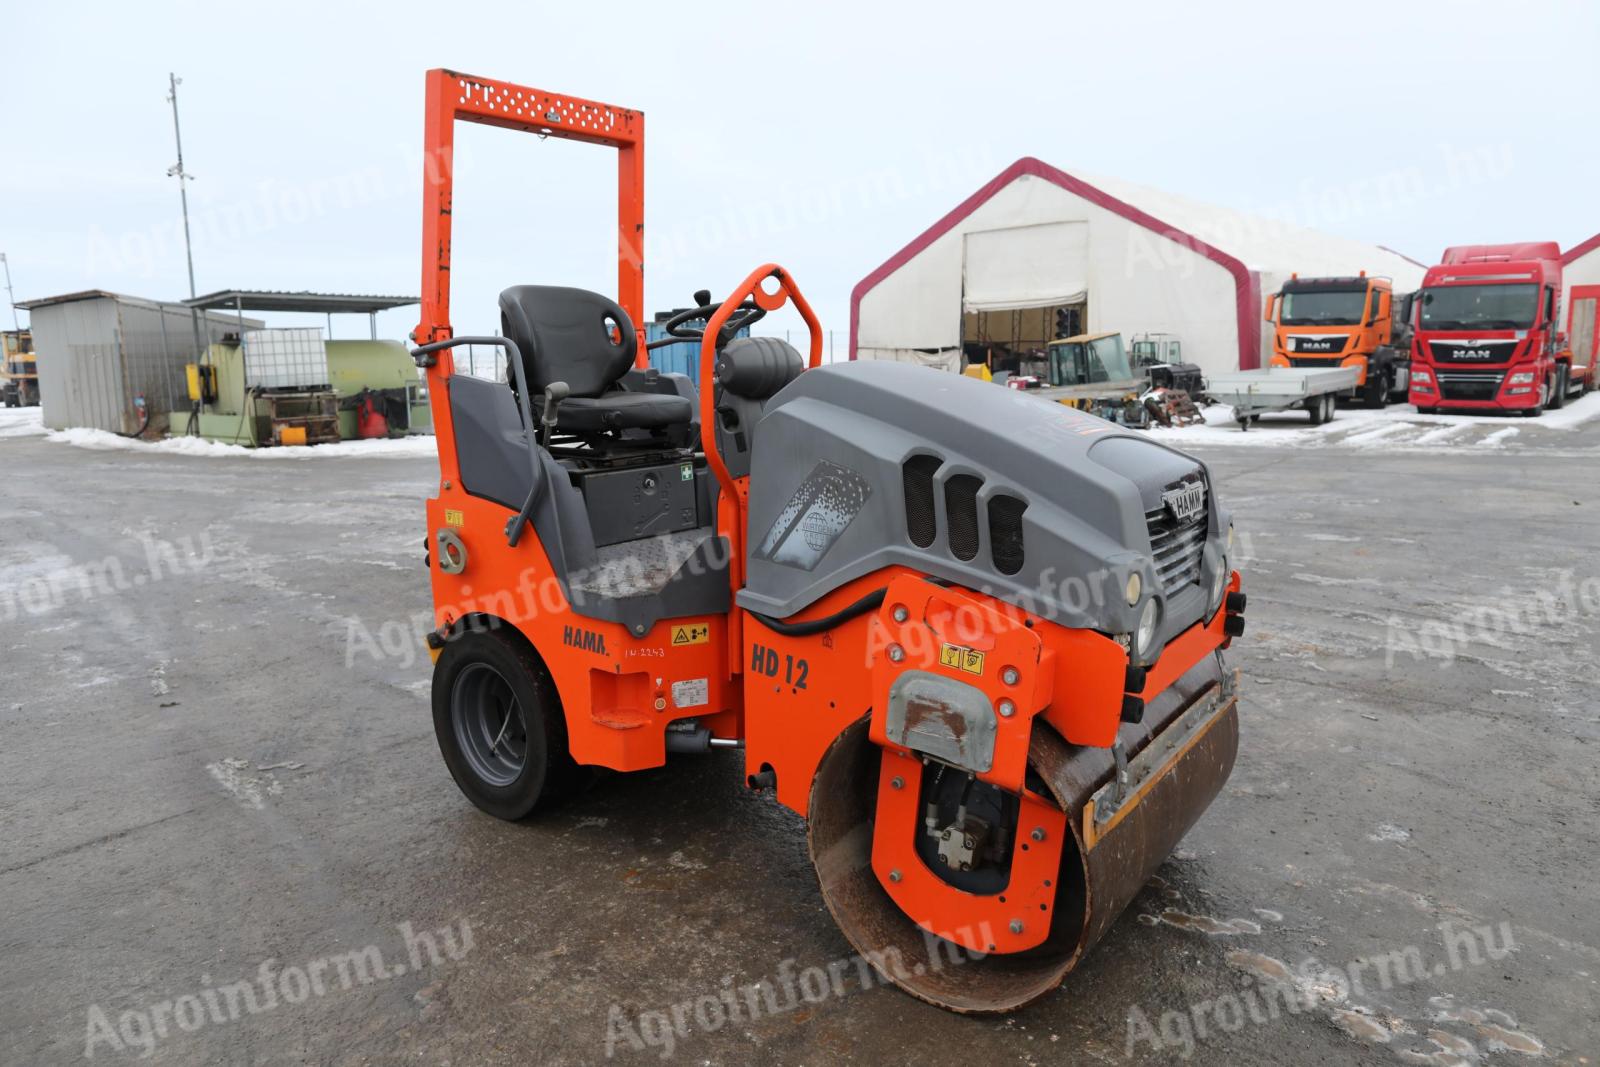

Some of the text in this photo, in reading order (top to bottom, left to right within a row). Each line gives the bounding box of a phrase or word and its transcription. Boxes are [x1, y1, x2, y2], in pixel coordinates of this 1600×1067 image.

[1302, 342, 1331, 350] MAN
[1452, 350, 1491, 358] MAN
[1176, 489, 1201, 517] HAMM
[751, 643, 808, 689] HD 12
